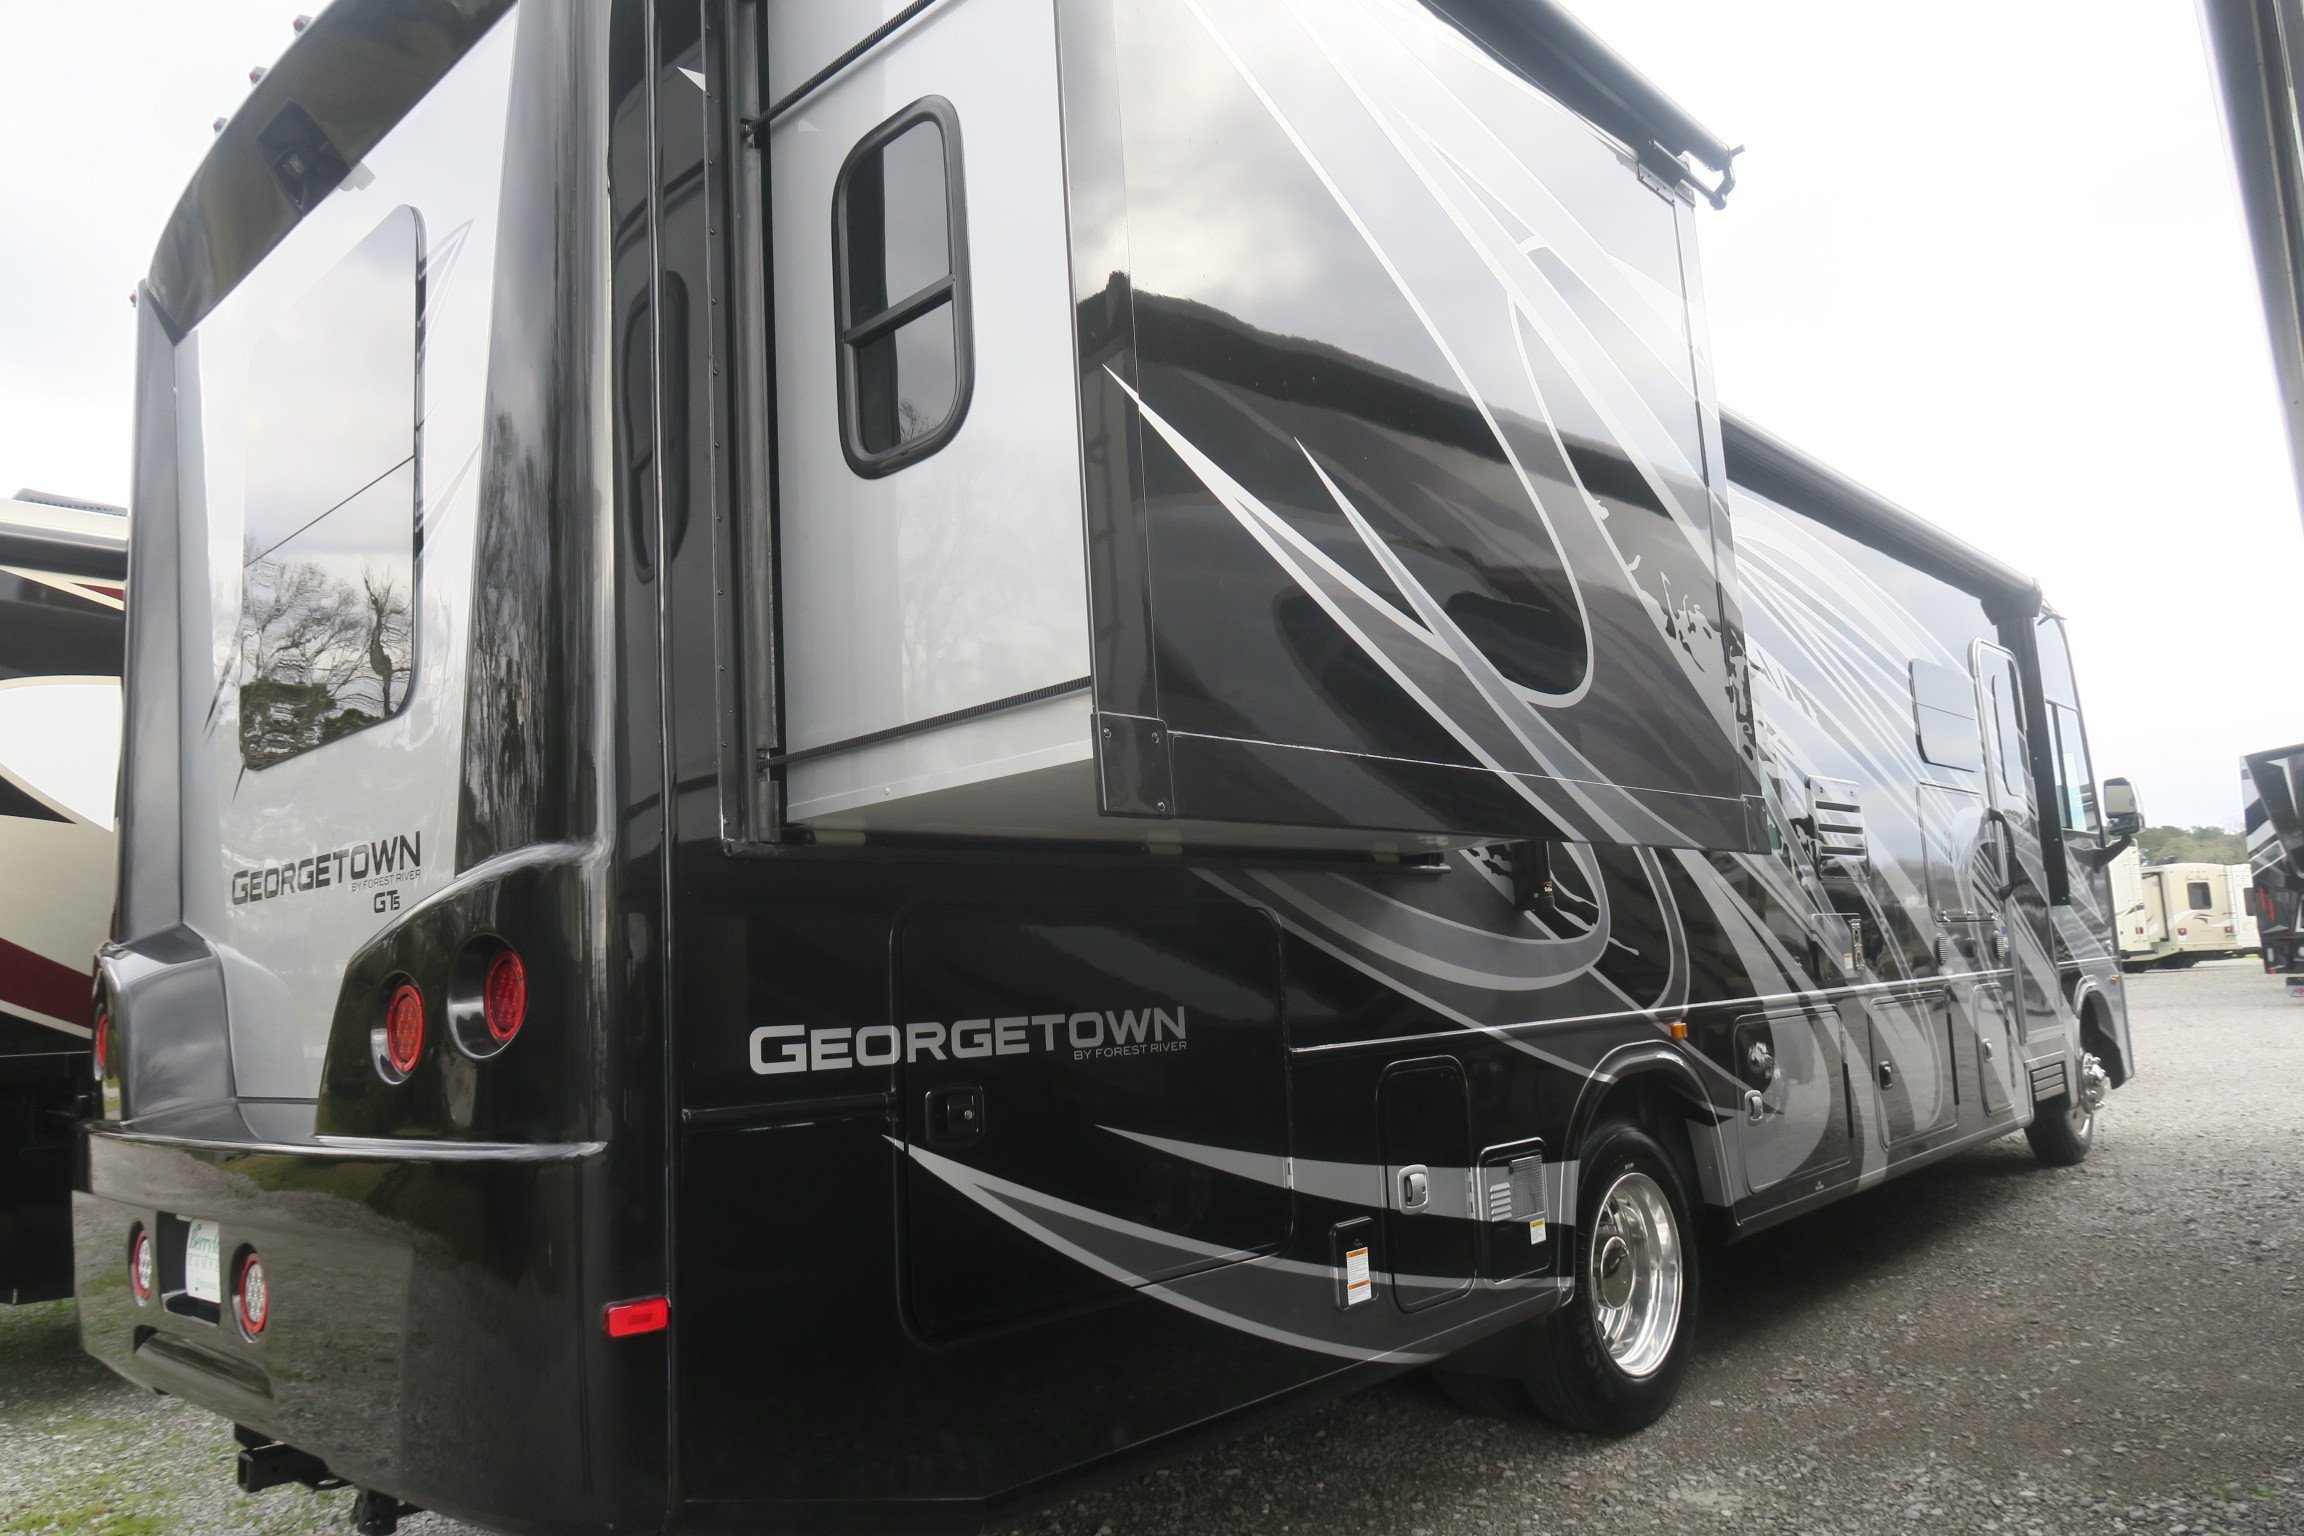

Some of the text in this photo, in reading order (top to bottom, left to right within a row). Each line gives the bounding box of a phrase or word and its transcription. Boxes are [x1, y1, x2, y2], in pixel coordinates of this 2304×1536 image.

[231, 830, 421, 906] GEORGETOWN
[351, 869, 421, 892] BY FOREST RIVER
[749, 1005, 1186, 1075] GEORGETOWN
[1073, 1040, 1187, 1061] BY FOREST RIVER
